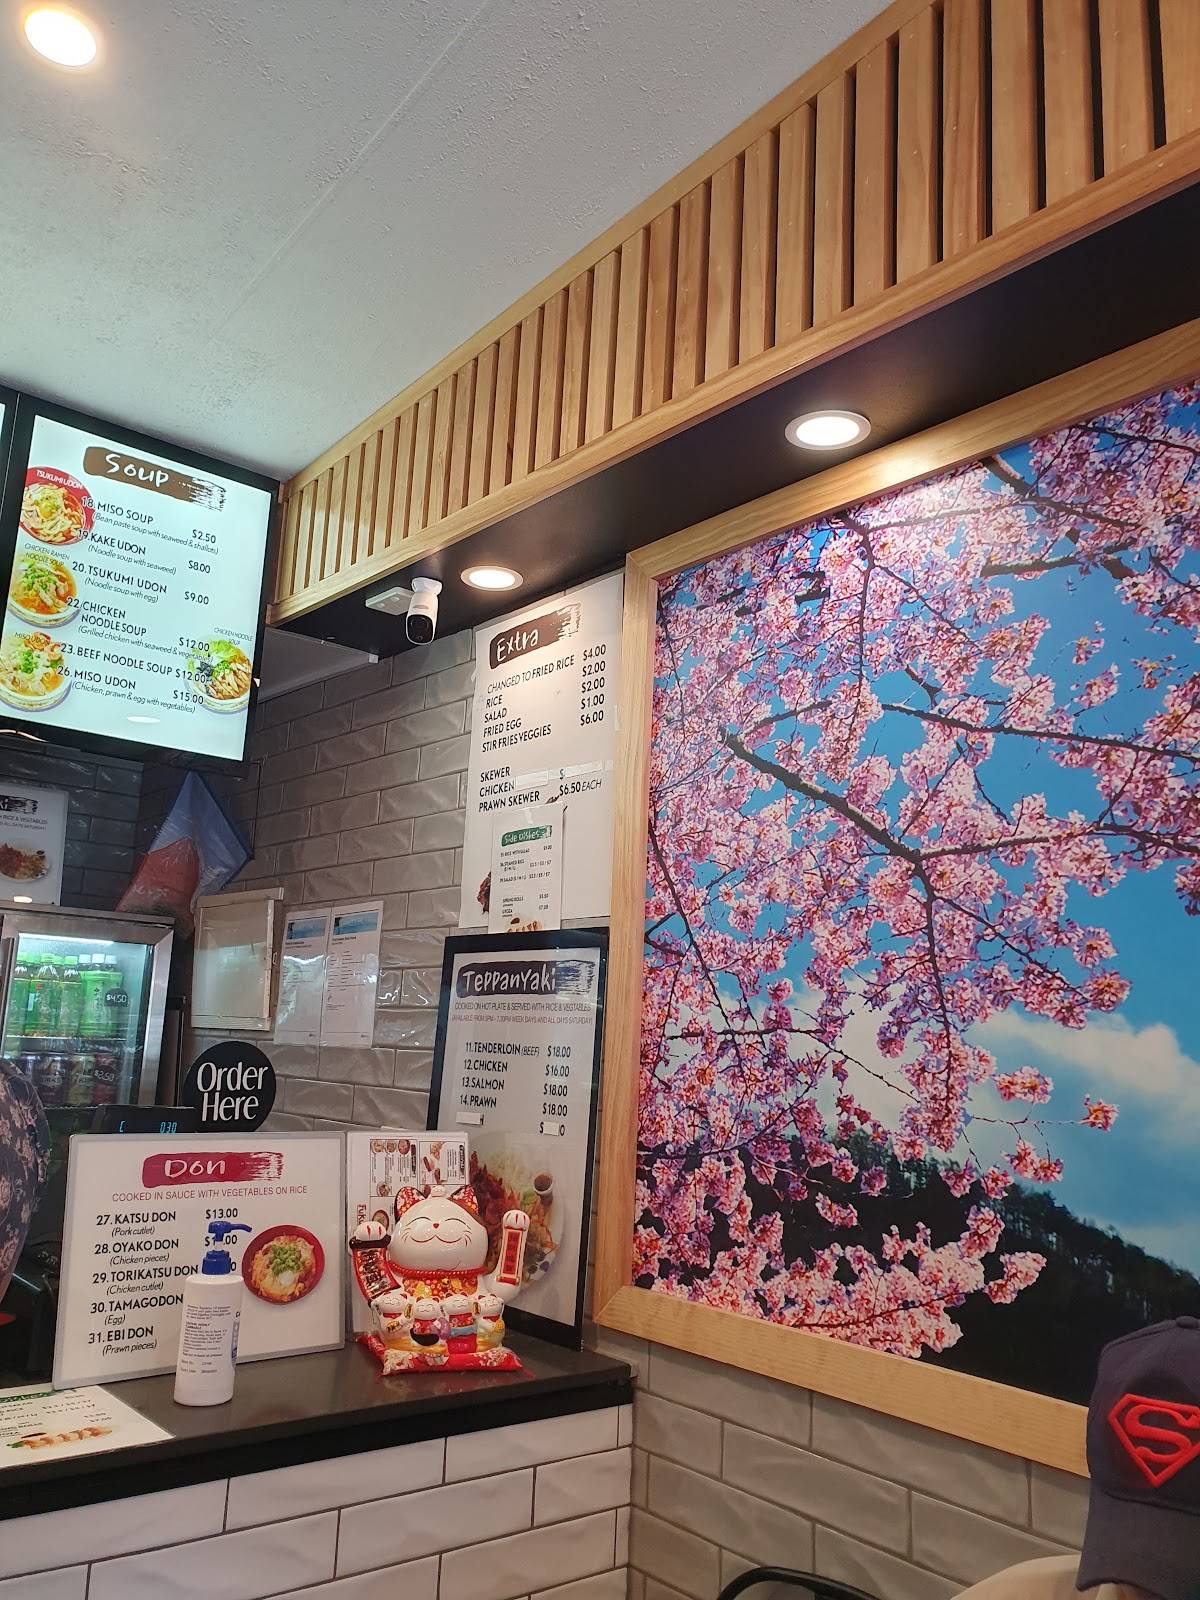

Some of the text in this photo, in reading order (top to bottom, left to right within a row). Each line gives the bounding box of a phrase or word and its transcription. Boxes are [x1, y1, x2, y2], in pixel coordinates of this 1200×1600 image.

[105, 454, 169, 488] Soup
[81, 496, 154, 524] 18. MISO SOUP
[93, 512, 115, 524] (Bean
[113, 519, 131, 530] paste
[131, 525, 147, 534] soup
[148, 529, 161, 538] with
[161, 533, 188, 547] seaweed
[188, 539, 194, 548] &
[191, 529, 217, 544] $2.50
[24, 543, 50, 556] CHICKEN
[90, 532, 115, 548] KAKE
[117, 540, 146, 556] UDON
[88, 544, 177, 575] (Noodle soup with seaweed)
[72, 561, 167, 593] 20. TSUKUMI UDON
[84, 577, 159, 604] (Noodle soup with egg)
[184, 591, 210, 605] $9.00
[82, 601, 126, 619] CHICKEN
[81, 614, 147, 637] NOODLE SOUP
[78, 625, 104, 638] (Grilled
[104, 631, 130, 644] chicken
[131, 638, 144, 648] with
[144, 641, 172, 655] seaweed
[172, 646, 178, 655] &
[179, 637, 210, 652] $12.00
[496, 628, 539, 663] Extra
[60, 643, 76, 655] 23.
[76, 646, 101, 662] BEEF
[103, 653, 144, 670] NOODLE
[146, 662, 173, 676] SOUP
[582, 643, 607, 661] $4.00
[57, 665, 136, 690] 26. MISO UDON
[485, 660, 606, 709] RICE $2.00
[487, 655, 575, 694] CHANGED TO FRIED RICE
[71, 680, 196, 714] (Chicken, prawn & egg with vegetables)
[484, 676, 605, 723] SALAD $2.00
[483, 693, 605, 738] FRIED EGG $1.00
[482, 710, 604, 753] STIR FRIES VEGGIES $6.00
[480, 766, 511, 783] SKEWER
[478, 778, 602, 813] PRAWN SKEWER $6.50 EACH
[479, 780, 514, 798] CHICKEN
[491, 1002, 507, 1011] PLATE
[511, 1002, 530, 1011] SERVED
[531, 1002, 545, 1011] WITH
[521, 1046, 540, 1057] (BEEF)
[547, 1045, 571, 1058] $18.00
[197, 1061, 269, 1092] Order
[545, 1064, 570, 1078] $16.00
[543, 1083, 568, 1097] $18.00
[201, 1092, 260, 1122] Here
[542, 1102, 568, 1117] $18.00
[164, 1158, 226, 1178] Don
[112, 1185, 308, 1203] COOKED IN SAUCE WITH VEGETABLES ON RICE
[96, 1208, 239, 1226] 27. KATSU DON $13.00
[111, 1225, 156, 1238] (Pork cutlet)
[94, 1235, 238, 1255] 28. OYAKO DON $1.00
[109, 1253, 170, 1267] (Chicken pieces)
[92, 1264, 199, 1284] 29. TORIKATSU DON
[106, 1281, 164, 1296] (Chicken cutlet)
[90, 1303, 107, 1314] 30.
[104, 1314, 126, 1326] (Egg)
[88, 1325, 154, 1344] 31. EBI DON
[102, 1339, 158, 1356] (Prawn pieces)
